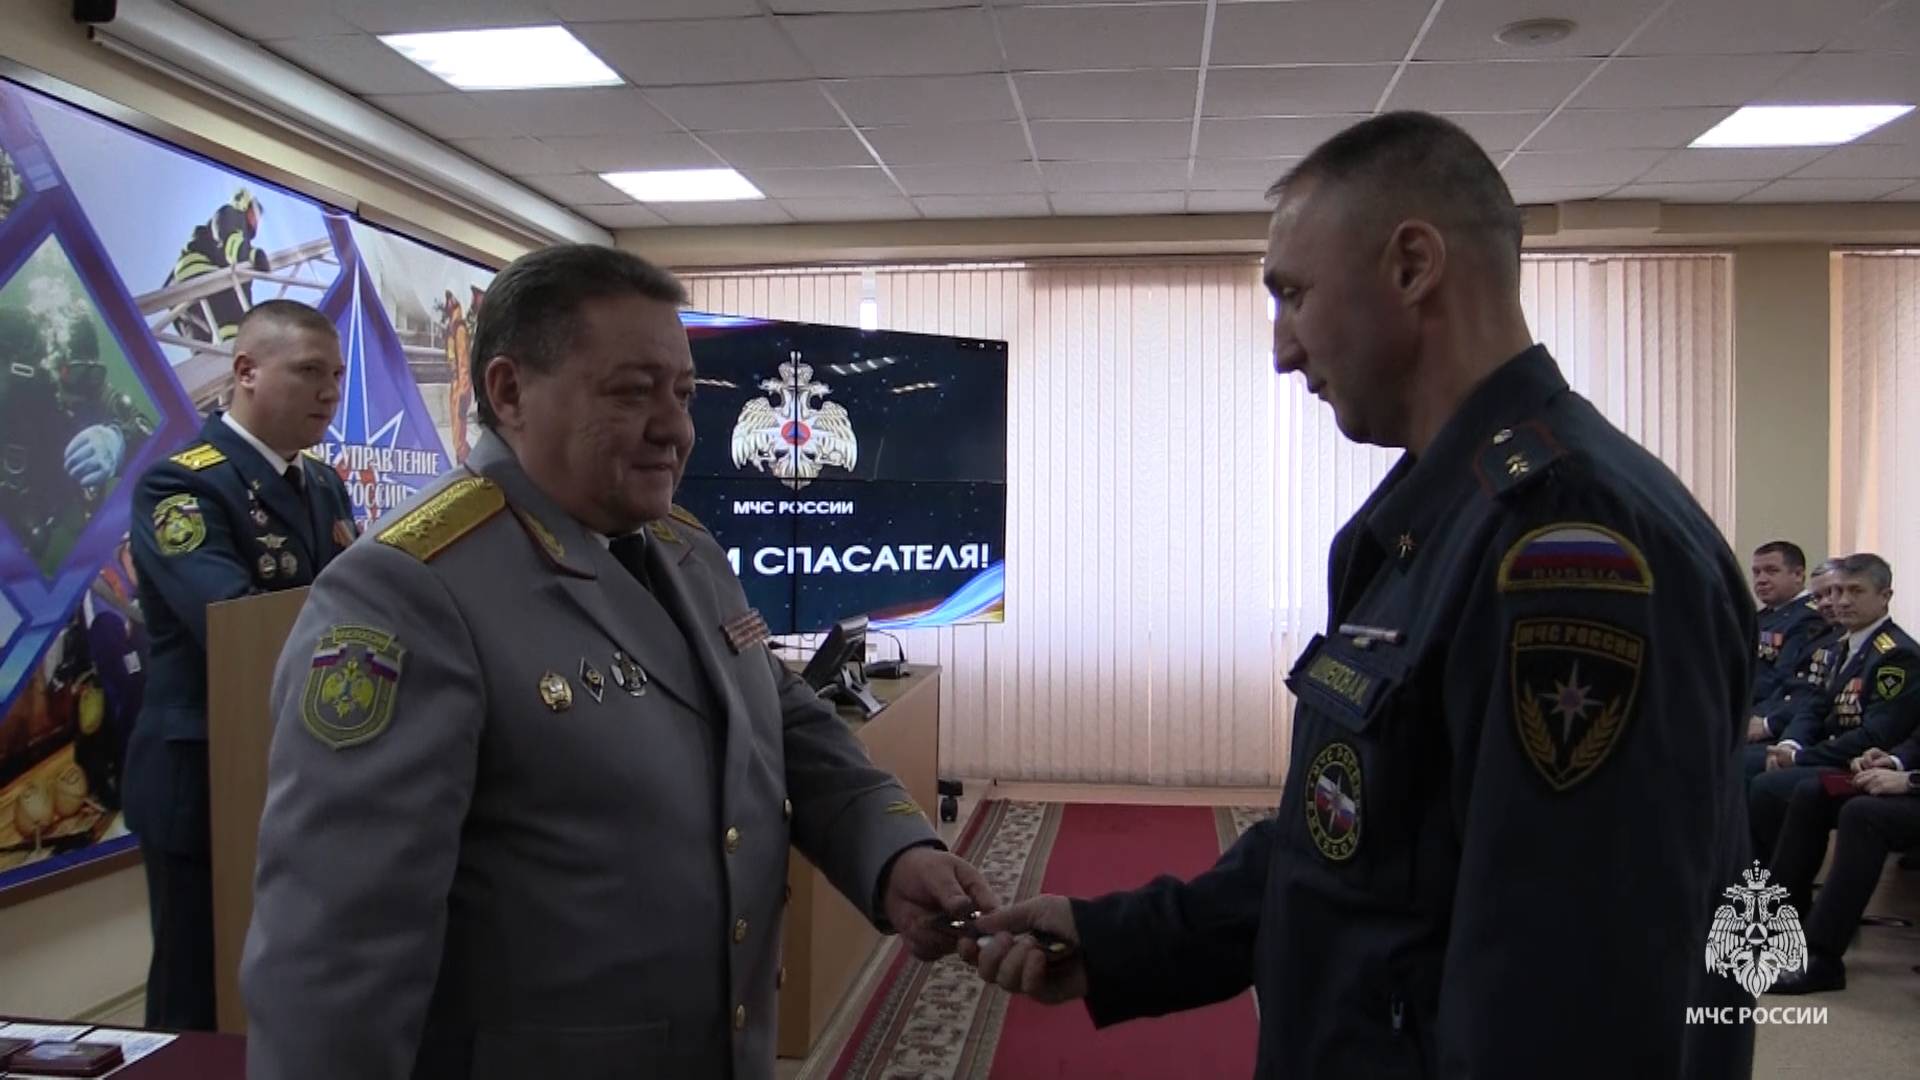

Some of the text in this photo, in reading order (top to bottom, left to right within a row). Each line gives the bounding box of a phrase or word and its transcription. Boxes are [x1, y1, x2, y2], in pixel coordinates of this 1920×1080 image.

[341, 443, 440, 475] УПРАВЛЕНИЕ
[733, 500, 854, 515] МЧС РОССИИ
[753, 542, 989, 576] СПАСАТЕЛЯ!
[1531, 567, 1622, 583] RUSSIA
[1518, 624, 1641, 662] МЧС РОССИИ
